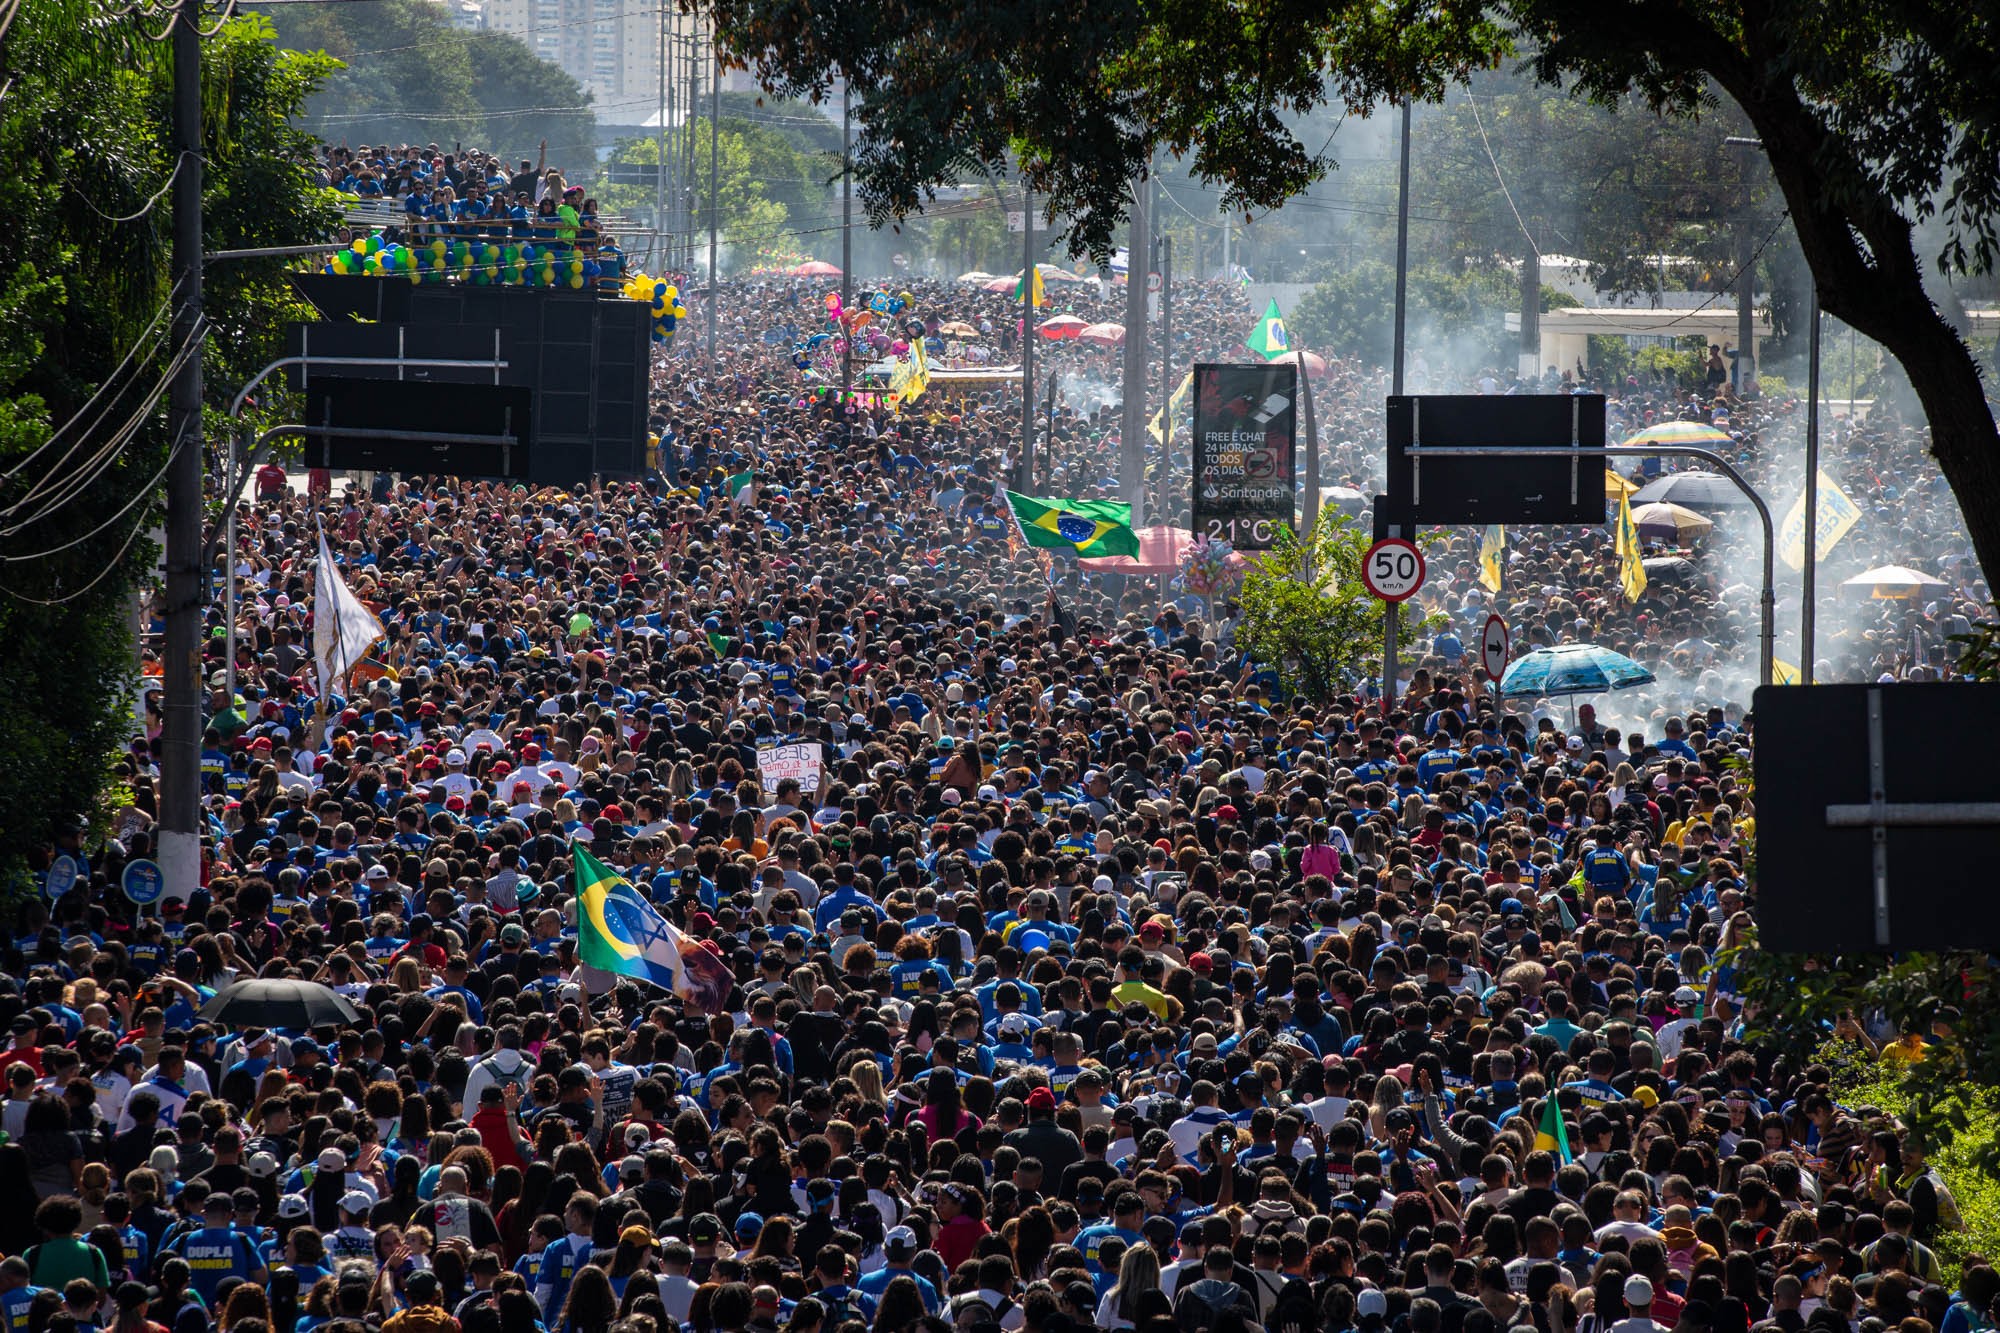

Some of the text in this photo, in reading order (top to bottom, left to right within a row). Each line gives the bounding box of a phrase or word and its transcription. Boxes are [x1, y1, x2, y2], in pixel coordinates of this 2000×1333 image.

[1205, 432, 1230, 441] FREE
[1240, 432, 1266, 441] CHAT
[1205, 443, 1217, 452] 24
[1205, 454, 1240, 464] TODOS
[1205, 466, 1245, 475] OS DIAS
[1221, 487, 1285, 498] Santander
[1208, 519, 1272, 542] 21°C
[1376, 553, 1415, 580] 50
[334, 1237, 372, 1249] JESUS
[187, 1246, 233, 1258] DUPLA
